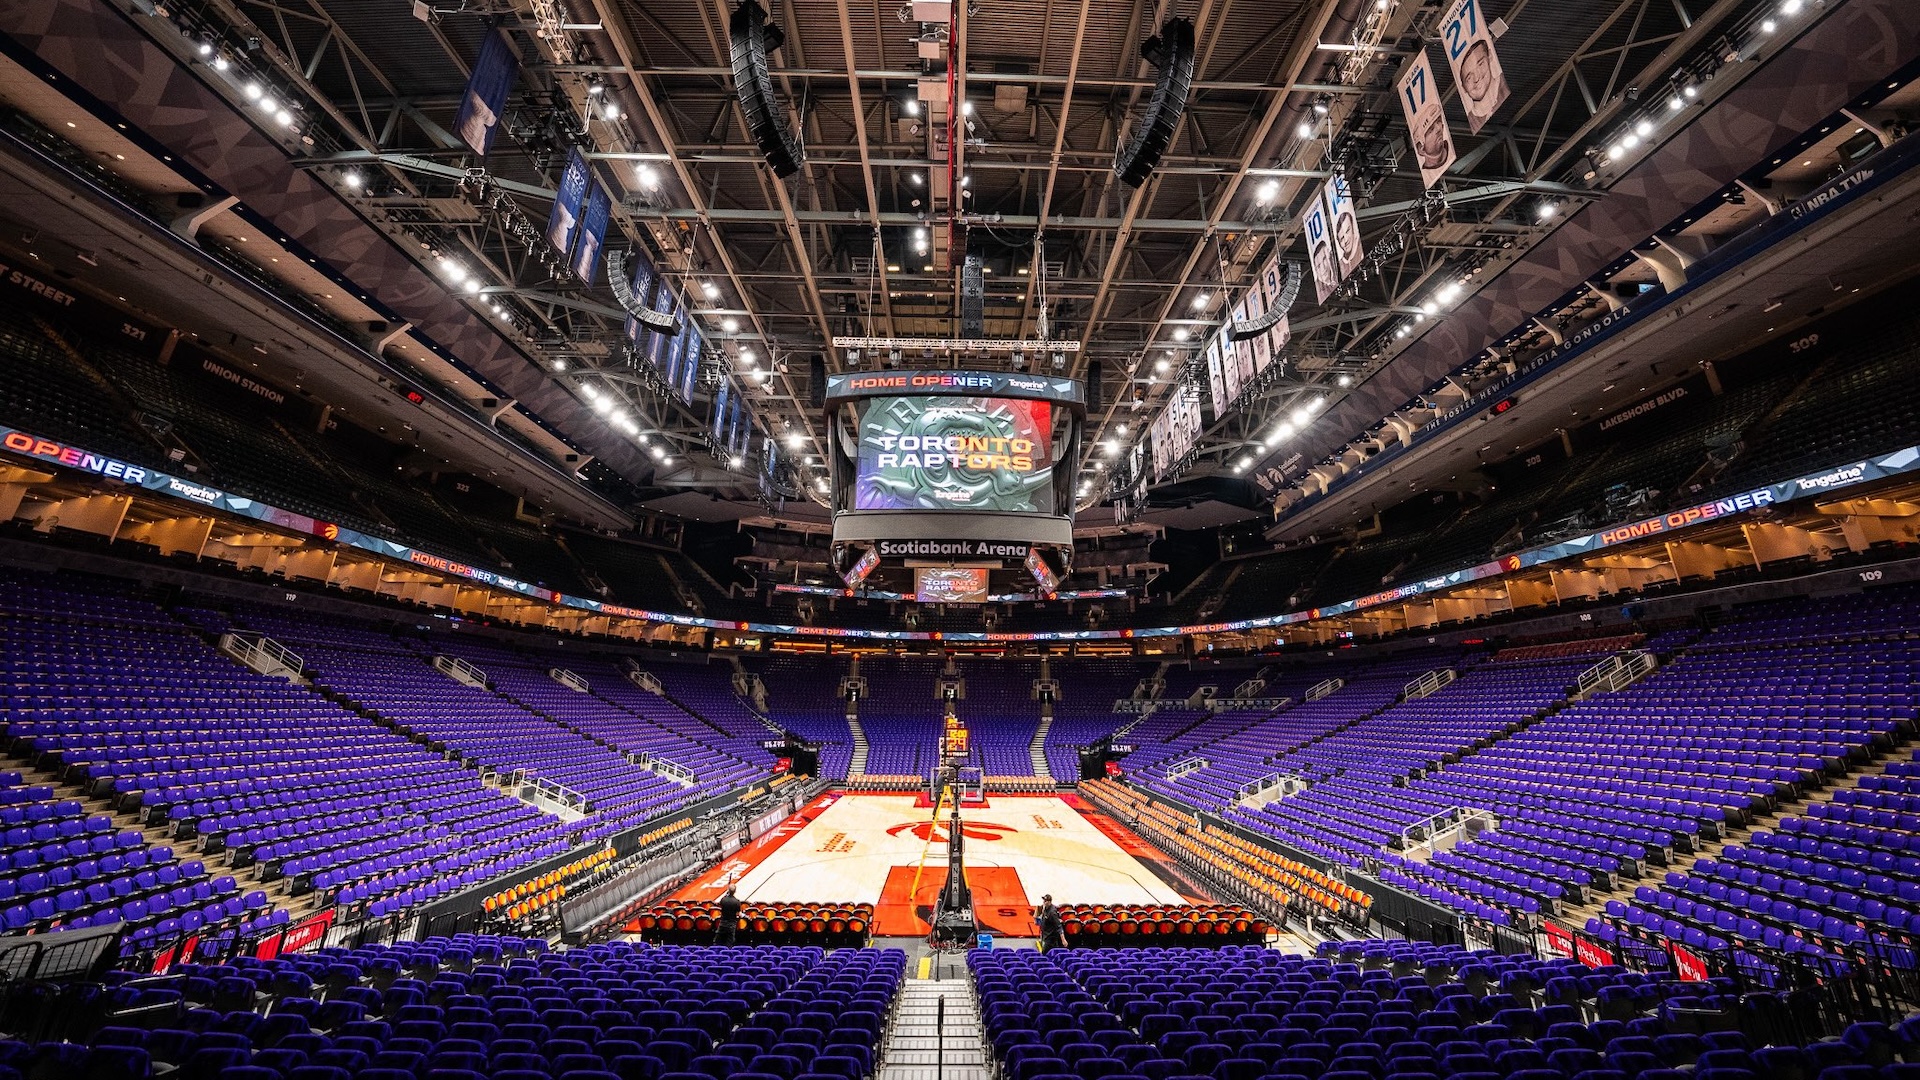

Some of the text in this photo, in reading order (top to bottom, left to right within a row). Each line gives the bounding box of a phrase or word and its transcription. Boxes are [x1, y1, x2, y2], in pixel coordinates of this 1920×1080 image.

[1446, 0, 1477, 61] 27
[1405, 67, 1426, 116] 17
[1806, 187, 1840, 211] NBA
[1308, 211, 1323, 245] 10
[9, 271, 76, 306] STREET
[1269, 271, 1277, 296] 9
[121, 323, 146, 341] 321
[1789, 333, 1820, 353] 309
[1426, 306, 1631, 432] THE FOSTER HEWITT MEDIA GONDOLA
[202, 359, 285, 404] UNION STATION
[850, 375, 1044, 391] HOME OPENER Tangerine
[1599, 387, 1689, 432] LAKESHORE BLVD.
[878, 435, 1033, 454] TORONTO
[4, 432, 217, 501] OPENER Tangerine
[878, 453, 1033, 471] RAPTORS
[1525, 454, 1542, 468] 308
[1601, 466, 1863, 545] HOME OPENER Tangerine
[880, 541, 1027, 556] Scotiabank Arena
[411, 551, 447, 570] HOME
[448, 562, 491, 582] OPENER
[1859, 570, 1883, 583] 109
[1356, 596, 1380, 608] HOME
[1381, 585, 1418, 601] OPENER
[601, 604, 627, 616] HOME
[629, 609, 667, 622] OPENER
[796, 627, 824, 635] HOME
[826, 628, 863, 637] OPENER
[1180, 626, 1208, 634] HOME
[1209, 621, 1246, 631] OPENER
